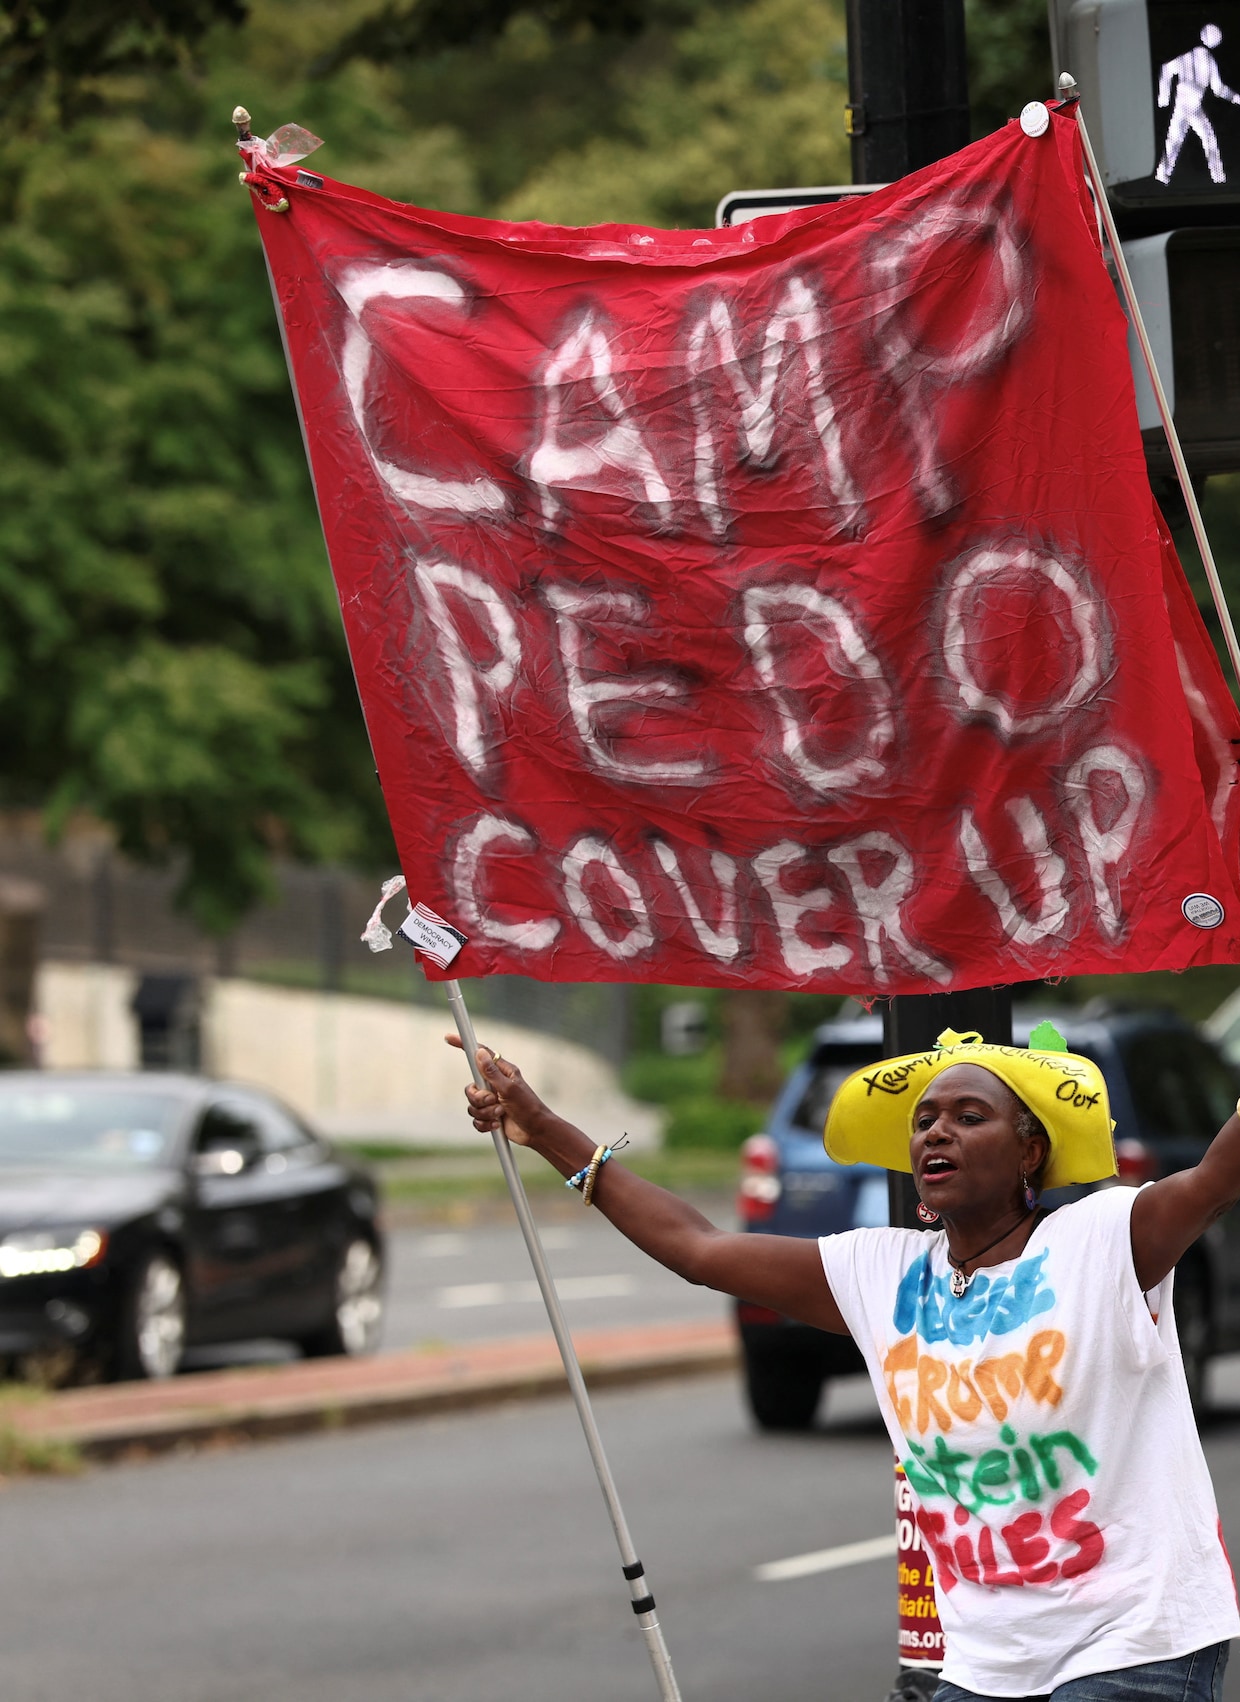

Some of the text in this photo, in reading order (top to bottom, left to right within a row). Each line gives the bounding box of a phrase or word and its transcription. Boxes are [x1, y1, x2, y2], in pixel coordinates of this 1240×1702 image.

[336, 200, 1030, 540] CAMP
[414, 547, 1106, 791] PEDO
[413, 918, 454, 950] DEMOCRACY
[420, 932, 437, 949] WINS
[451, 745, 1150, 985] COVER UP
